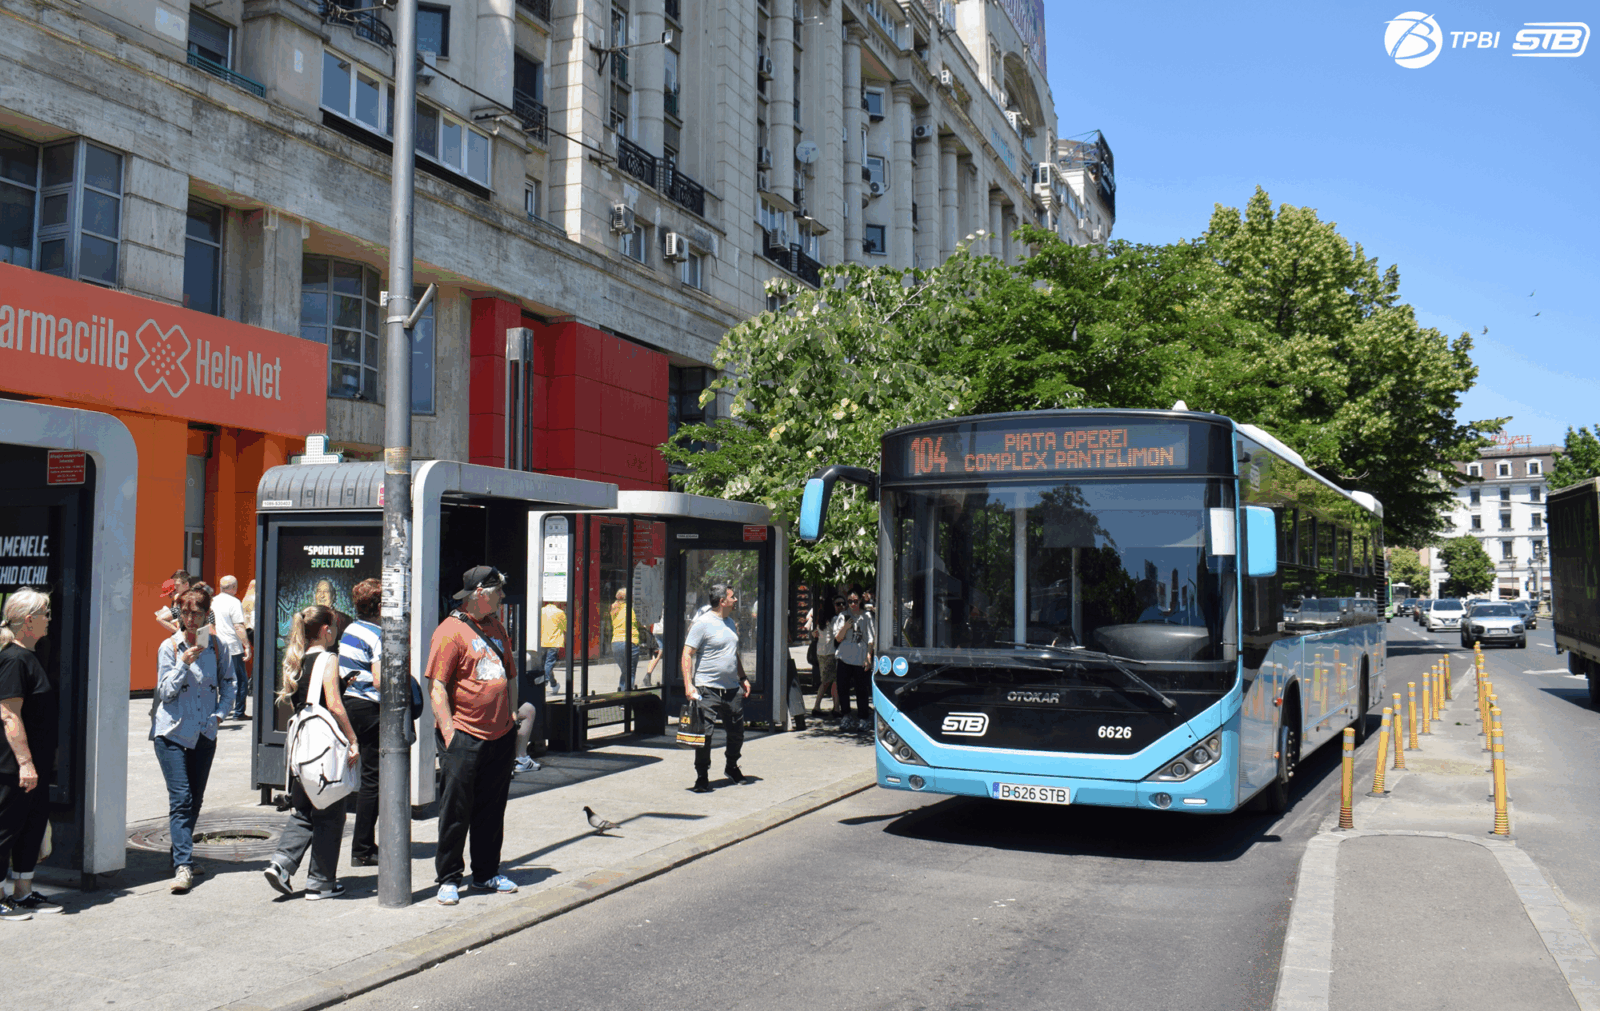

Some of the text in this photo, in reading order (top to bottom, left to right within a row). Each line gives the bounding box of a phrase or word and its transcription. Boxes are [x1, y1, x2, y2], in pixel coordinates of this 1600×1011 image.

[195, 338, 243, 400] Help
[247, 350, 282, 401] Net
[1004, 428, 1128, 451] PIATA OPEREI
[910, 436, 949, 476] 104
[964, 446, 1174, 472] COMPLEX PANTELIMON
[344, 545, 365, 556] ESTE
[0, 565, 19, 585] HID
[1007, 691, 1060, 704] OTOKAR
[941, 714, 986, 733] STB
[1097, 725, 1132, 739] 6626
[1002, 785, 1011, 798] B
[1039, 788, 1066, 803] STB
